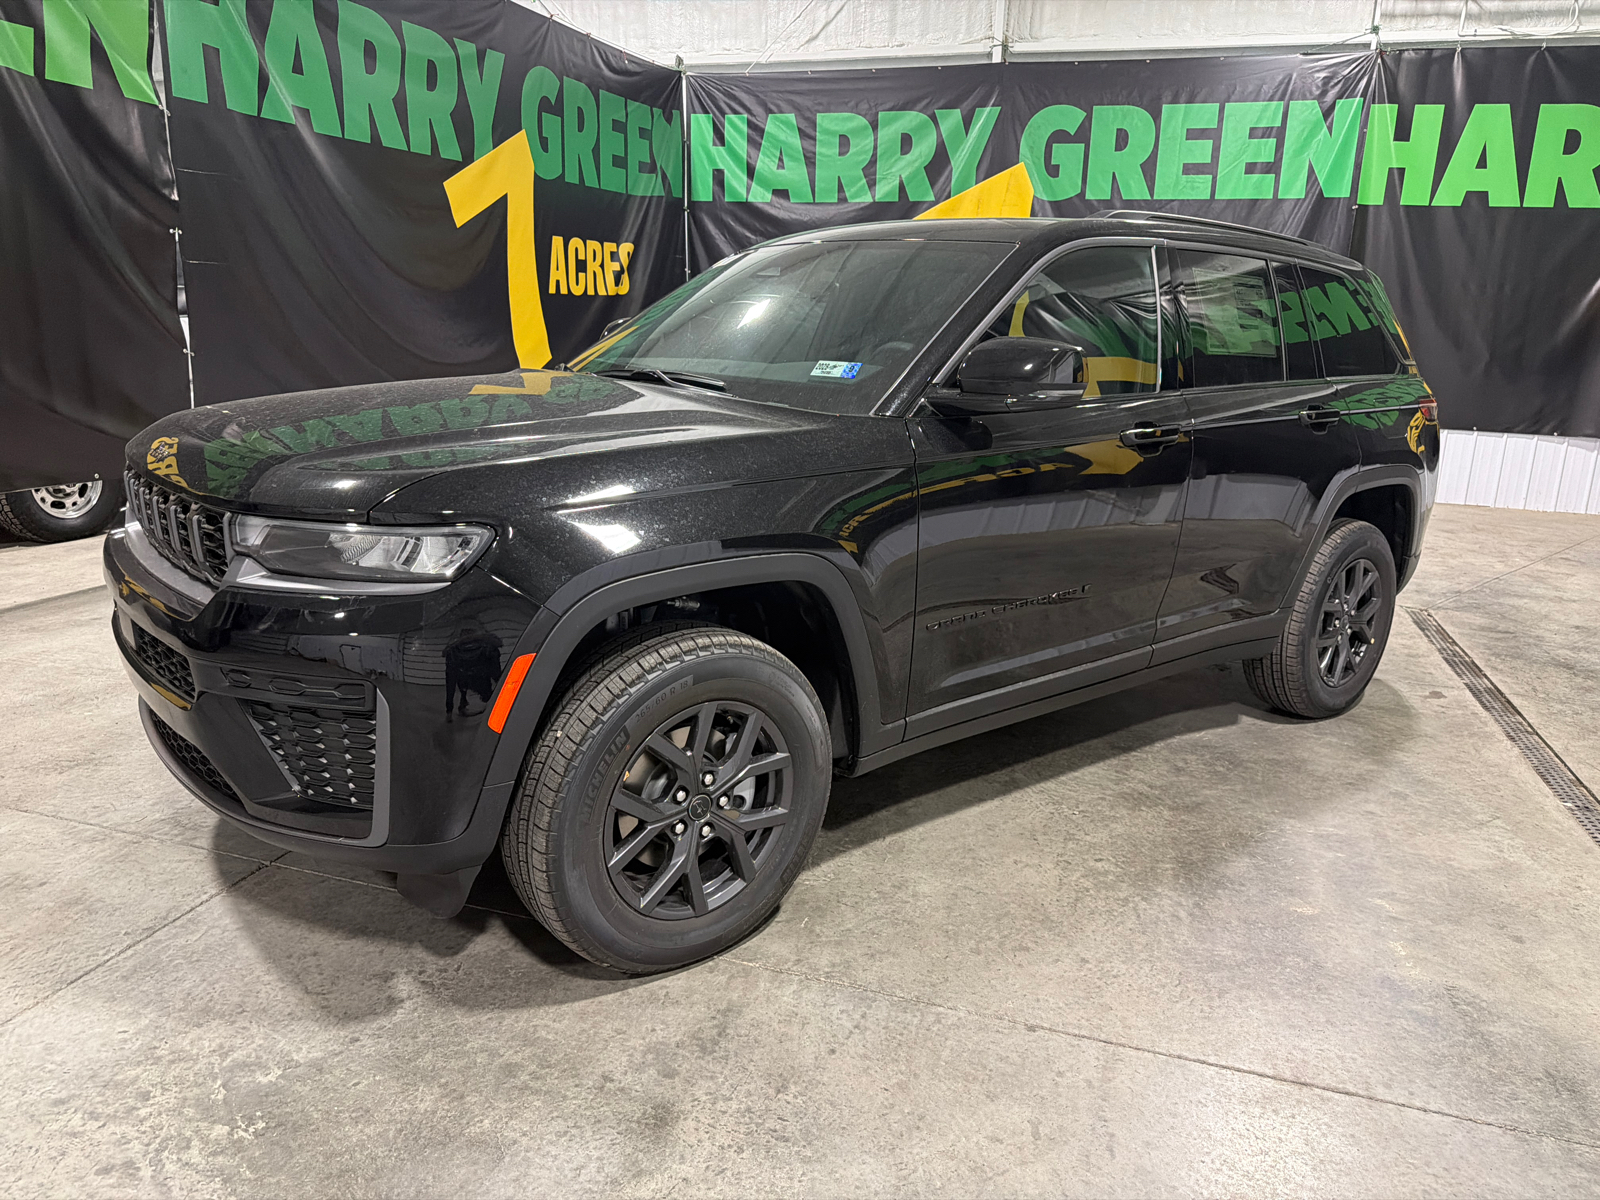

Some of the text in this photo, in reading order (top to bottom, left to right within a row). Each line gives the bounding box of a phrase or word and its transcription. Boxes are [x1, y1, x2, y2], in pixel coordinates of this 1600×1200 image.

[0, 0, 159, 106] N
[163, 0, 683, 198] HARRY GREEN
[690, 106, 1001, 203] HARRY
[1019, 97, 1363, 201] GREEN
[549, 235, 634, 296] ACRES
